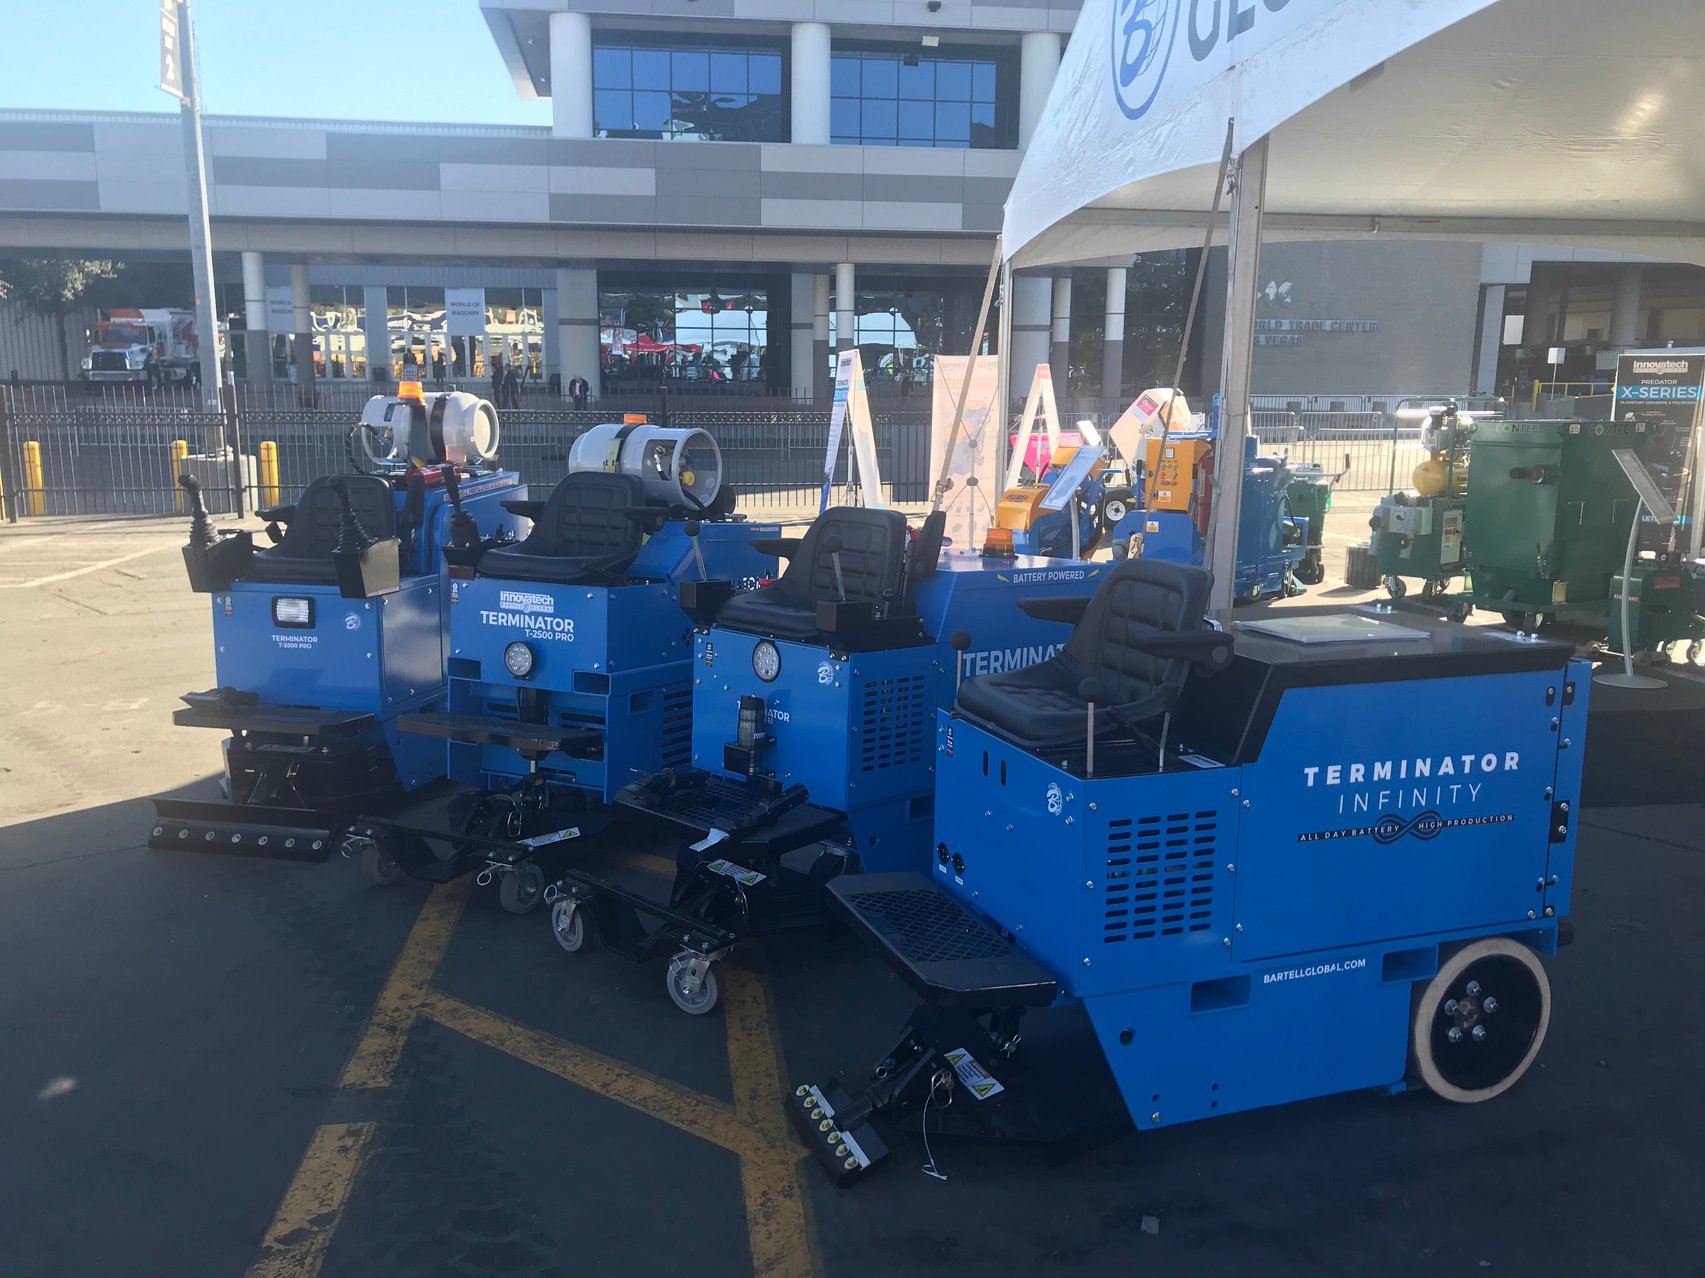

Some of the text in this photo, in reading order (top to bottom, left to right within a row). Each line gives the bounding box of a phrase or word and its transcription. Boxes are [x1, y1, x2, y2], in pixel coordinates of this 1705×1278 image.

[1288, 320, 1326, 331] TRADE
[1330, 320, 1377, 332] CENTER
[1265, 334, 1303, 345] VEGAS
[1633, 360, 1688, 368] Innovatech
[1621, 386, 1697, 398] X-SERIES
[1013, 570, 1085, 584] BATTERY POWERED
[500, 590, 554, 606] Innovatech
[480, 610, 575, 633] TERMINATOR
[271, 634, 318, 643] TERMINATOR
[525, 629, 574, 642] T-2500 PRO
[1304, 751, 1520, 787] TERMINATOR
[1338, 783, 1482, 814] INFINITY
[1300, 814, 1514, 841] ALL DAY BATTERY HIGH PRODUCTION
[1263, 958, 1366, 984] BARTELLGLOBAL.COM
